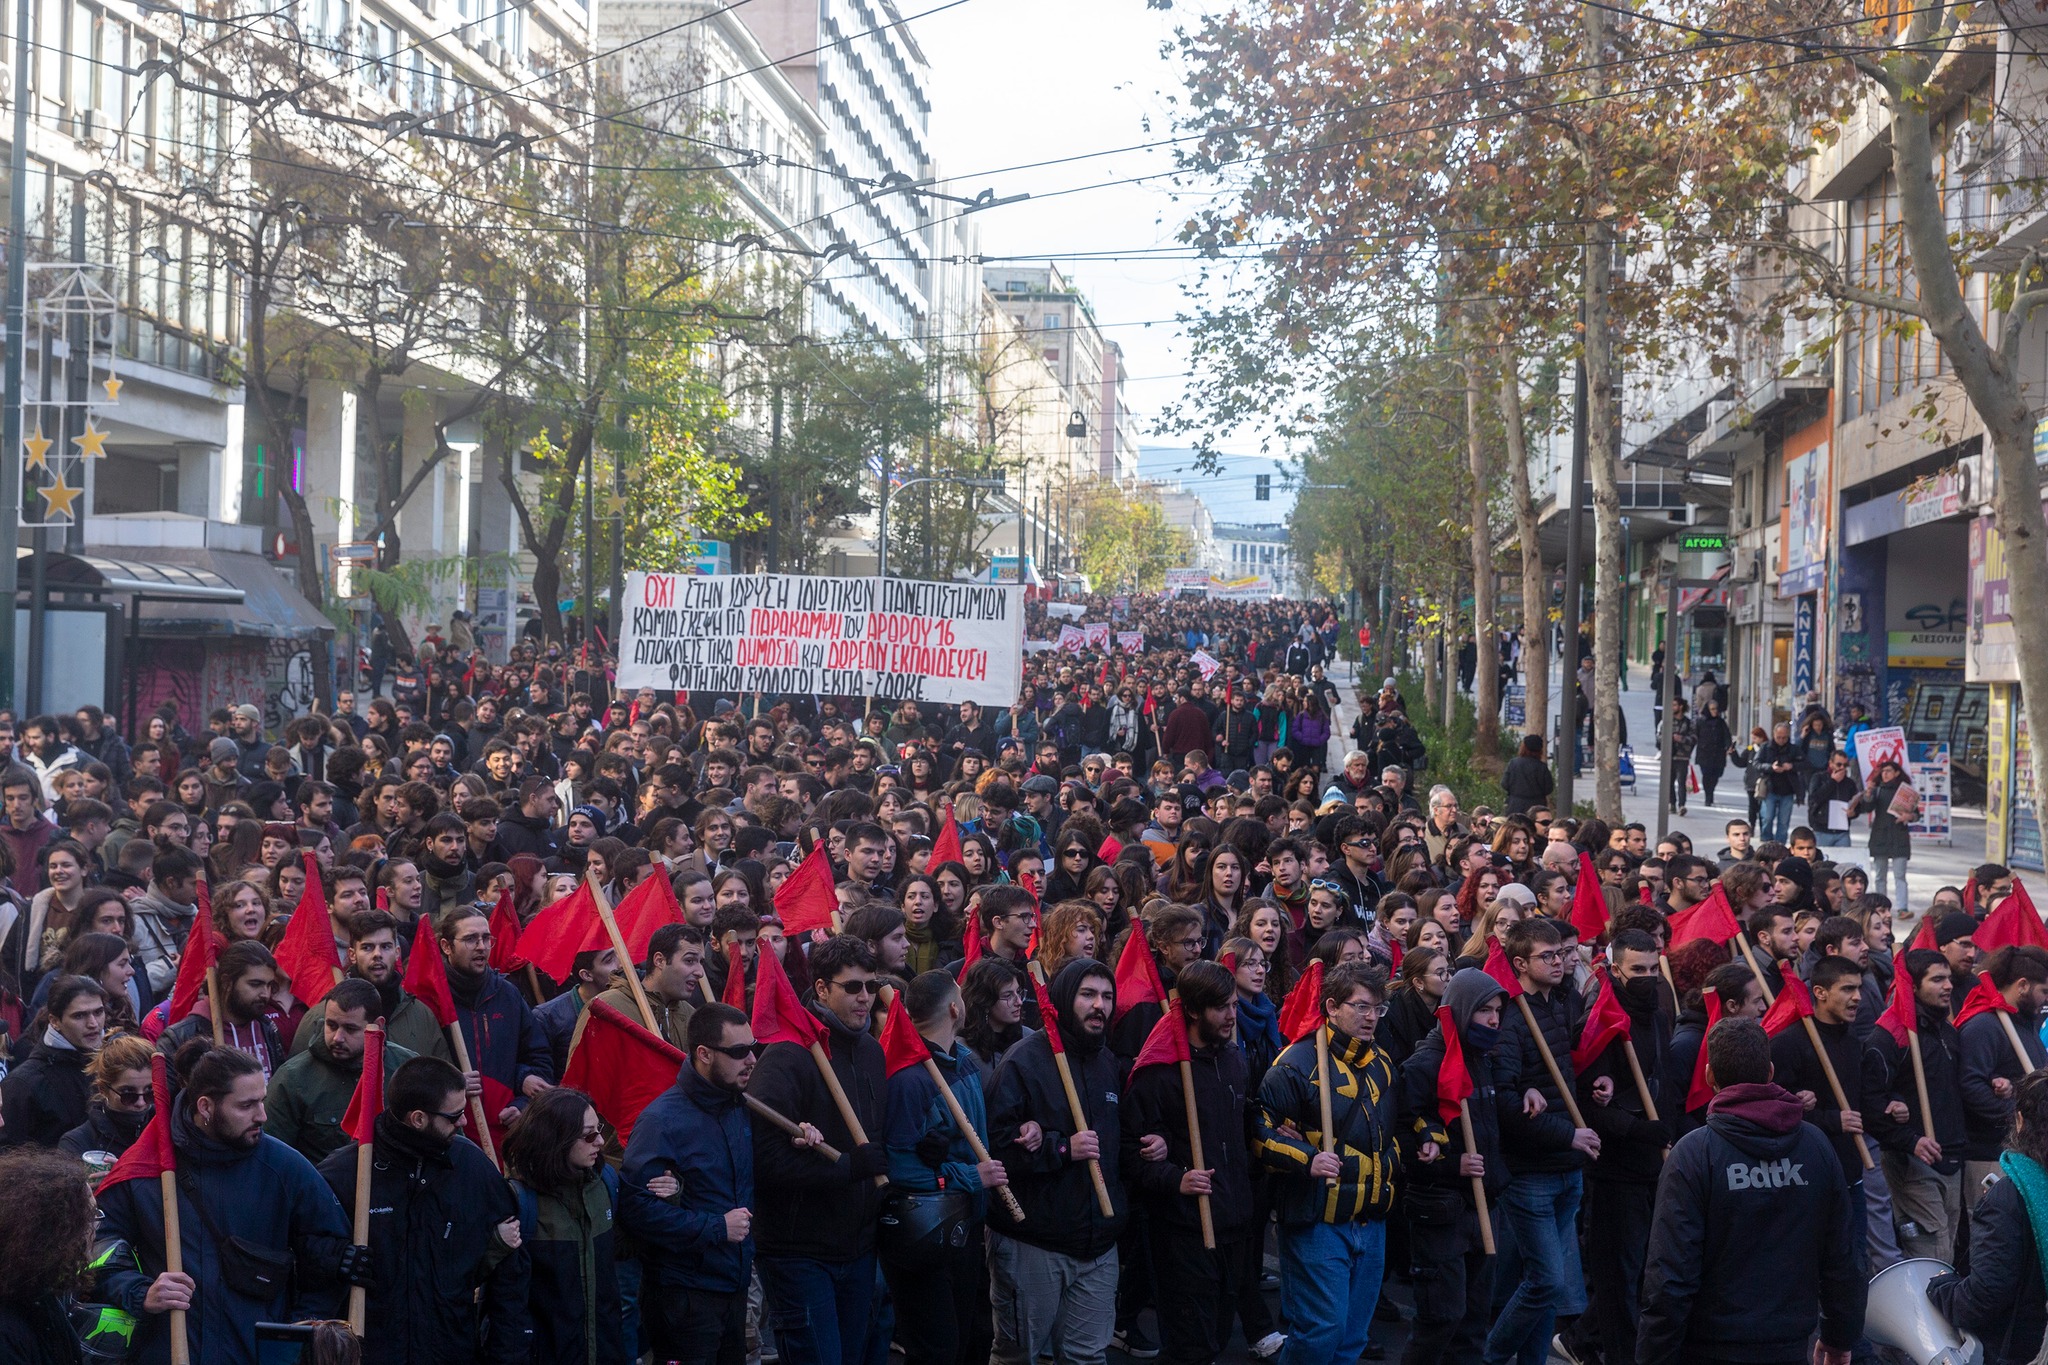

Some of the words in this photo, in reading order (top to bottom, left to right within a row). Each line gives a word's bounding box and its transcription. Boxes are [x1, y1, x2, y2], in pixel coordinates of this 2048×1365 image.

[1685, 538, 1723, 548] ΑΓΟΡΑ
[645, 574, 675, 608] ΟΧΙ
[685, 577, 723, 609] ΣΤΗΝ
[729, 576, 789, 609] ΙΔΡΥΣΗ
[797, 578, 875, 612] ΙΔΙΩΤΙΚΩΝ
[882, 580, 1007, 621] ΠΑΝΕΠΙΣΤΗΜΙΩΝ
[633, 606, 678, 638] ΚΑΜΙΑ
[679, 609, 723, 638] ΣΚΕΨΗ
[726, 608, 745, 636] ΓΙΑ
[750, 608, 842, 640] ΠΑΡΑΚΑΜΨΗ
[844, 615, 864, 639] ΤΟΥ
[867, 612, 932, 647] ΑΡΘΡΟΥ
[934, 618, 955, 647] 16
[634, 638, 733, 665] ΑΠΟΚΛΕΙΣΤΙΚΑ
[737, 637, 799, 667] ΔΗΜΟΣΙΑ
[802, 643, 824, 669] ΚΑΙ
[827, 640, 888, 671] ΔΩΡΕΑΝ
[891, 643, 987, 681] ΕΚΠΑΙΔΕΥΣΗ
[669, 663, 743, 692] ΦΟΙΤΗΤΙΚΟΙ
[747, 666, 814, 695] ΣΥΛΛΟΓΟΙ
[821, 669, 863, 696] ΕΚΠΑ
